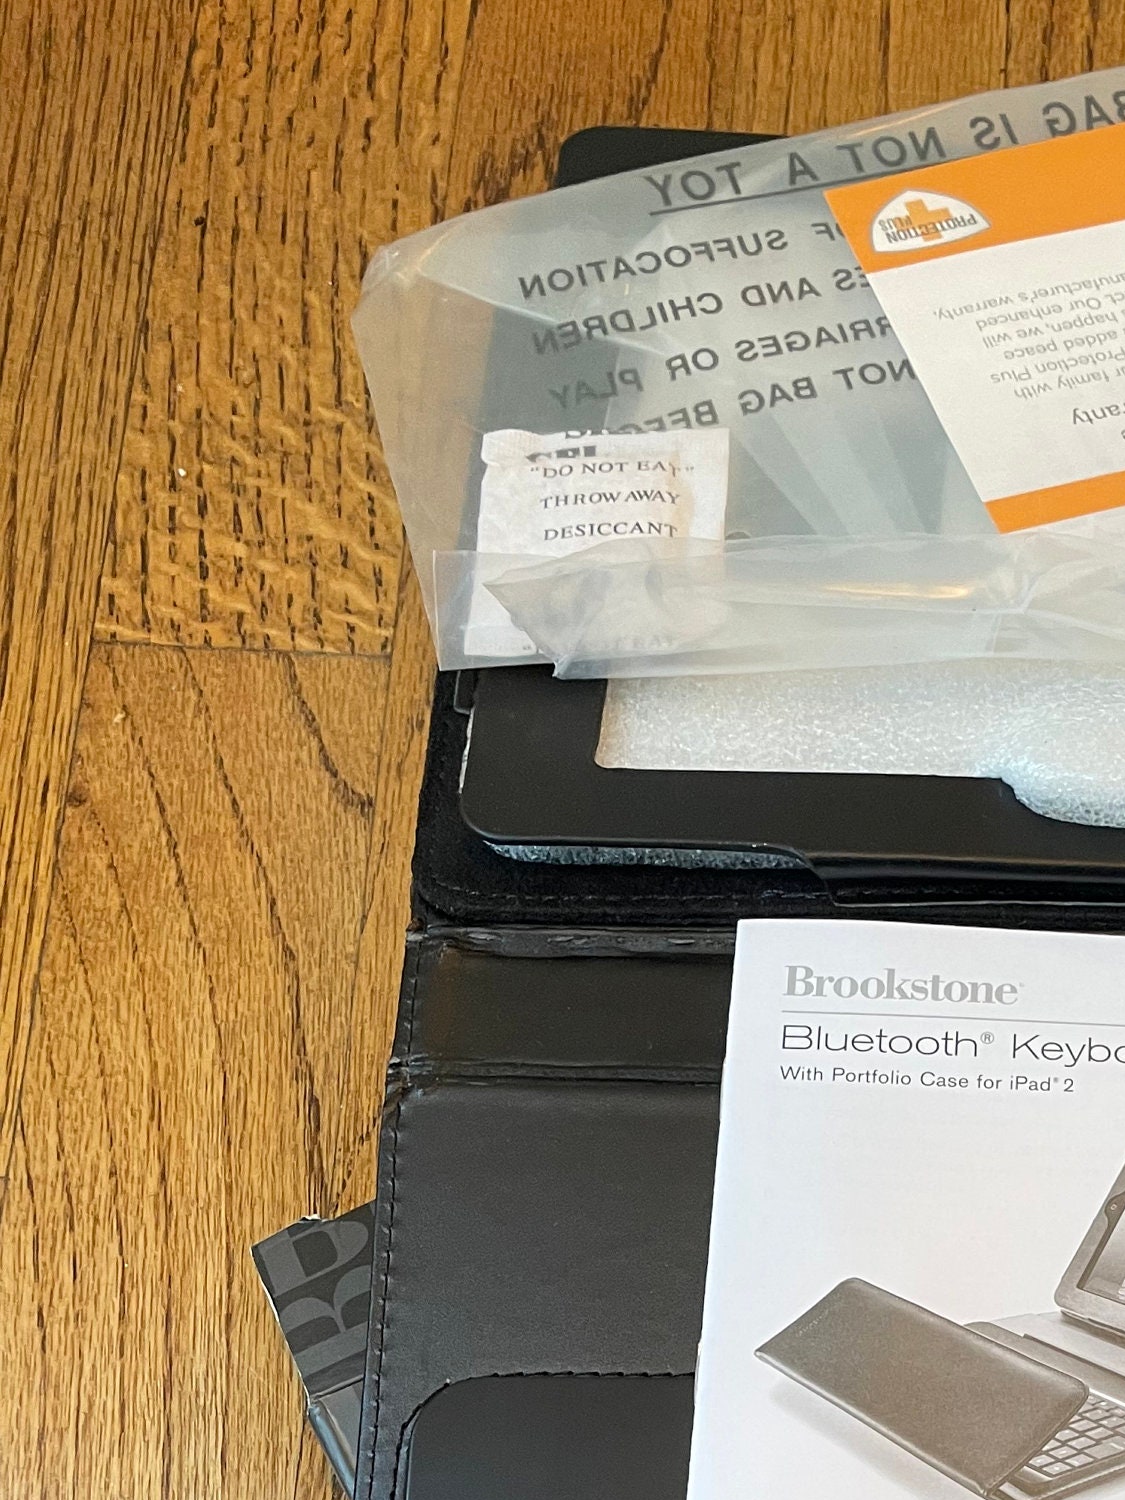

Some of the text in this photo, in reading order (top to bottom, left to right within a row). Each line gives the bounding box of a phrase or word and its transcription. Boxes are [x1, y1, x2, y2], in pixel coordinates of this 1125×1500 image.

[885, 214, 977, 243] PROTECTION
[932, 295, 1014, 320] warranty.
[1015, 326, 1044, 338] we
[1045, 311, 1118, 332] happen,
[982, 332, 1012, 349] will
[990, 366, 1032, 383] Plus
[583, 461, 629, 475] NOT
[540, 489, 681, 510] THROW AWAY
[544, 521, 679, 542] DESICCANT
[784, 966, 1017, 1005] Brookstone
[781, 1066, 822, 1080] With
[833, 1068, 911, 1085] Portfolio
[921, 1072, 968, 1087] Case
[977, 1075, 1002, 1089] for
[1064, 1079, 1073, 1092] 2
